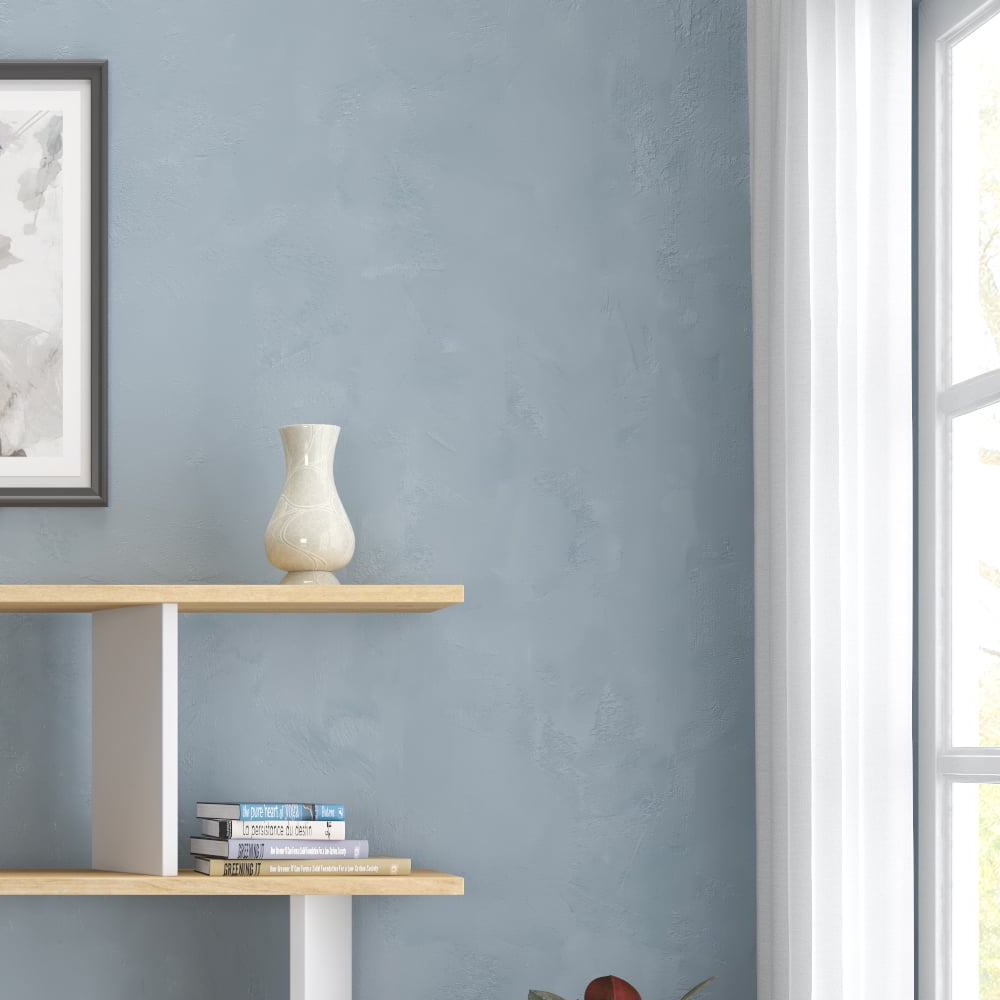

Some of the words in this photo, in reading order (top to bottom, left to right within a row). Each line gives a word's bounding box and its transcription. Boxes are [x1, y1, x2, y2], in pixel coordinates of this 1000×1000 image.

[242, 821, 249, 836] La
[251, 821, 284, 839] persistance
[294, 821, 313, 836] destin
[223, 862, 254, 876] GREENING
[254, 862, 262, 876] IT
